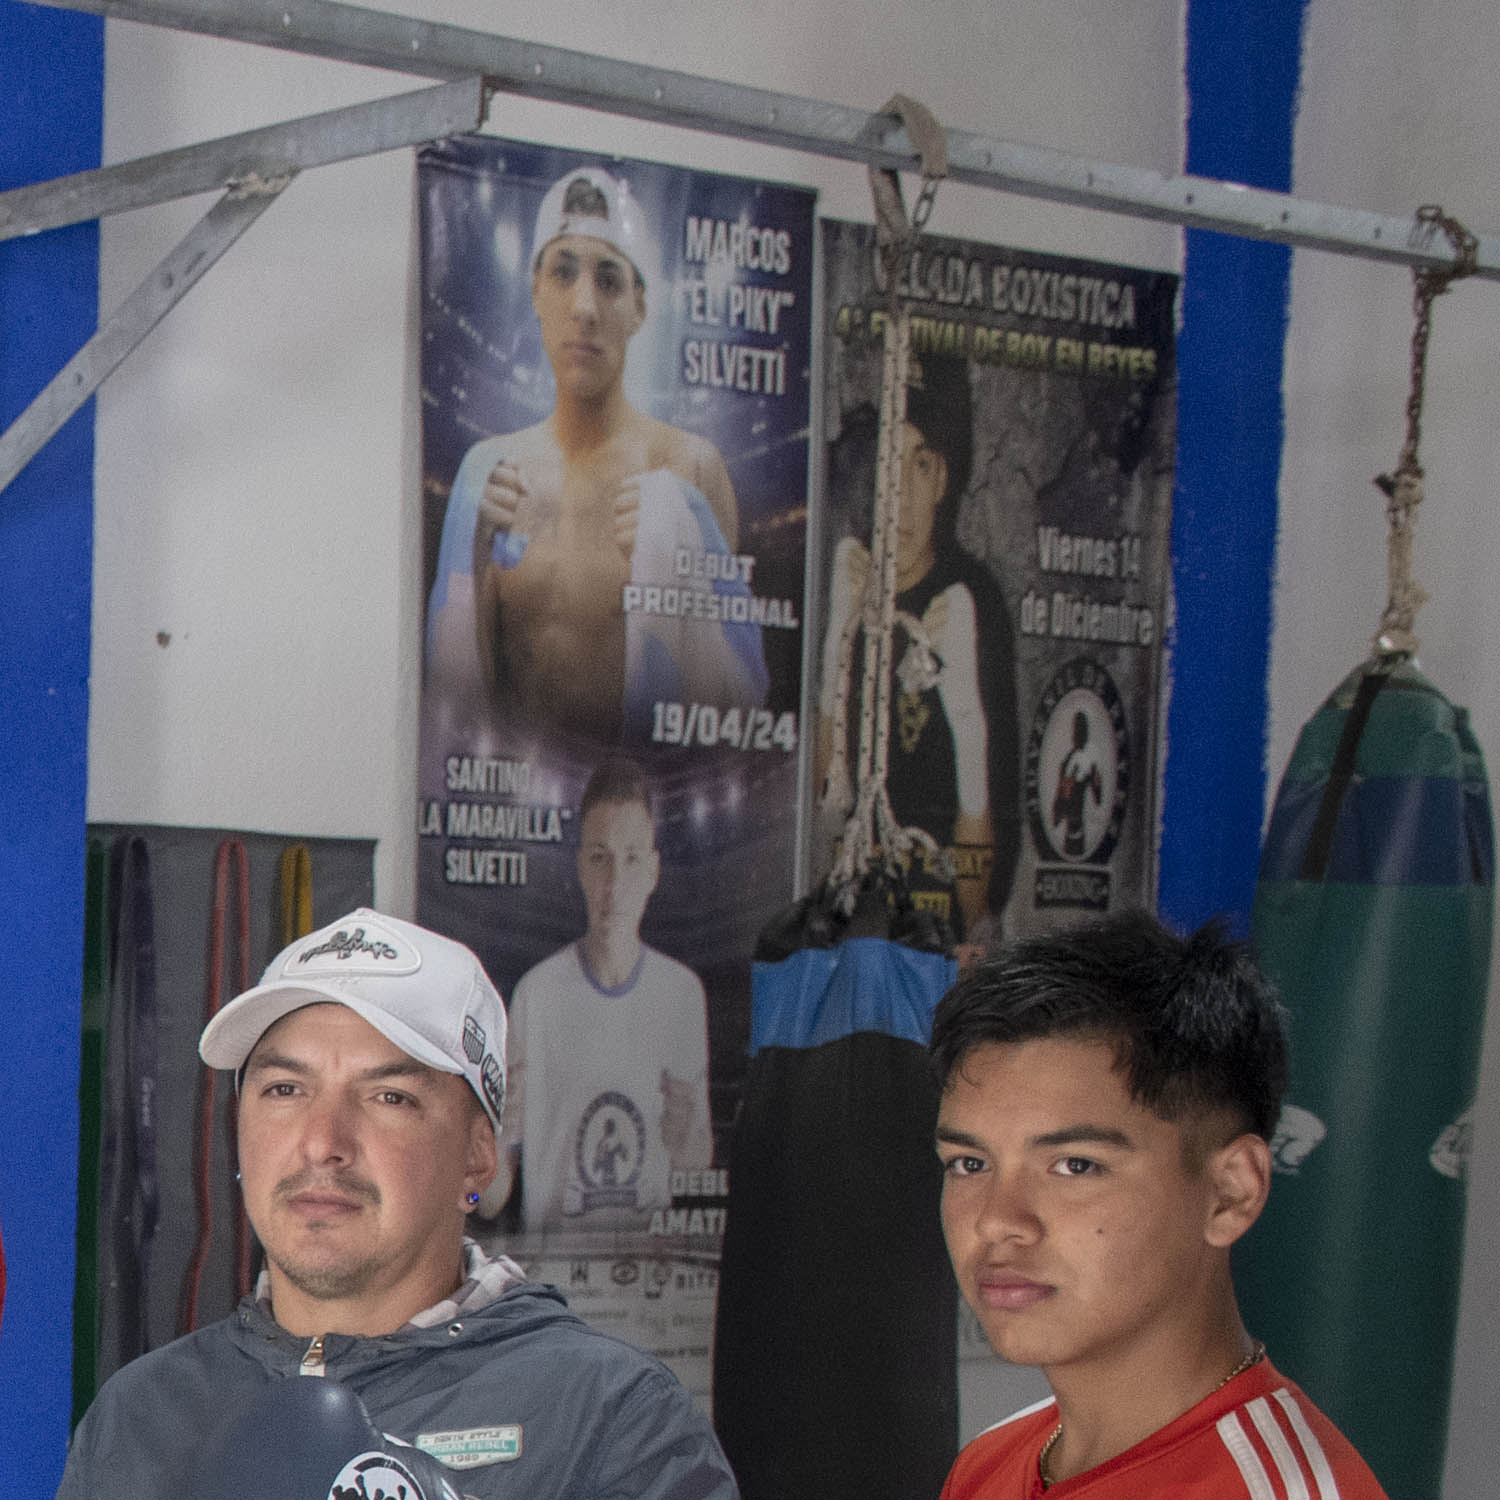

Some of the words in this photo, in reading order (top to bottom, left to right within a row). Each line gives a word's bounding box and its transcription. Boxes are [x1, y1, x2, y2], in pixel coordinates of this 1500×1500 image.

[686, 215, 791, 274] MARCOS
[685, 341, 786, 395] SILVETTI
[677, 547, 756, 583] DEBUT
[1037, 525, 1119, 576] Viernes
[1121, 536, 1142, 579] 14
[623, 585, 799, 629] PROFESIONAL
[1020, 591, 1048, 636] de
[1051, 592, 1154, 646] Diciembre
[652, 701, 798, 752] 19/04/24
[446, 756, 530, 793] SANTINO
[446, 848, 528, 885] SILVETTI
